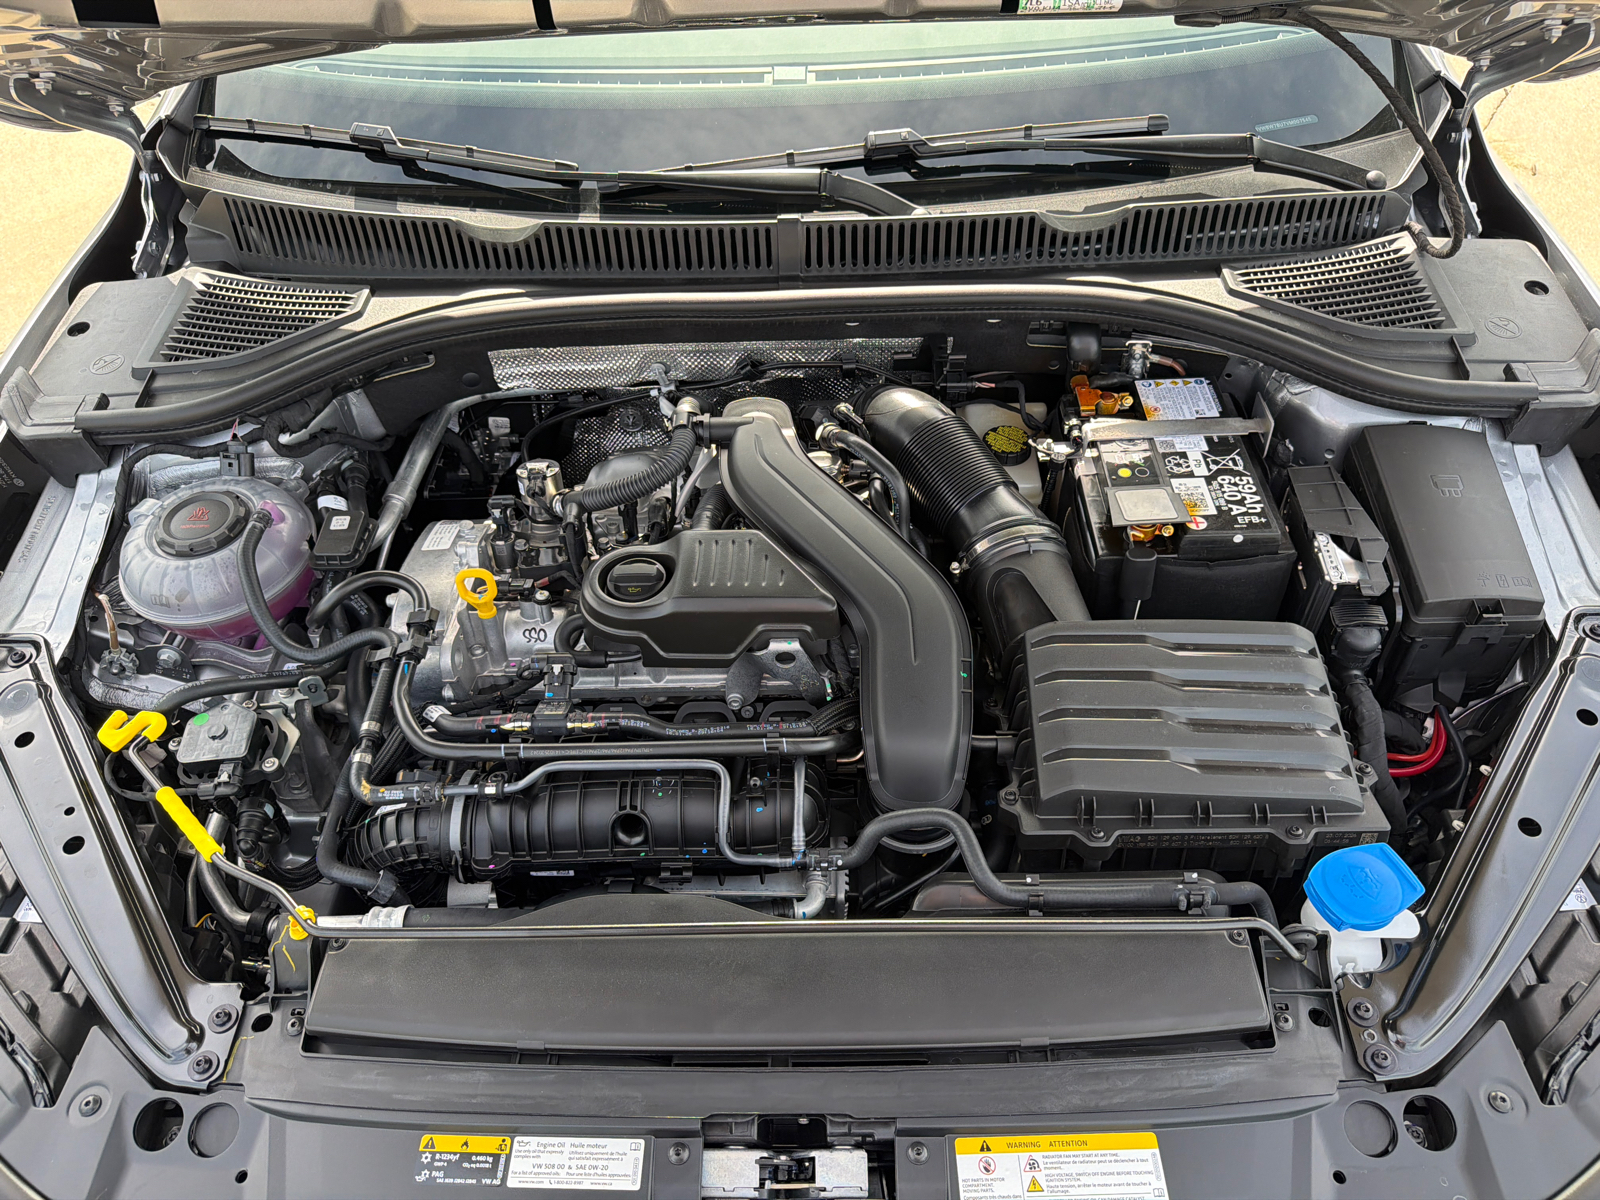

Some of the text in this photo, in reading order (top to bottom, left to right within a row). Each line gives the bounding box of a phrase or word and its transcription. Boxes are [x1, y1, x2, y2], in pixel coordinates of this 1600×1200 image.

[1192, 458, 1203, 470] Pb
[1217, 475, 1247, 516] 640 A
[1234, 475, 1265, 514] 59Ah
[1237, 516, 1268, 524] EFB+
[536, 1141, 556, 1149] Engine
[1049, 1140, 1088, 1148] ATTENTION
[435, 1154, 460, 1162] R-1234yf
